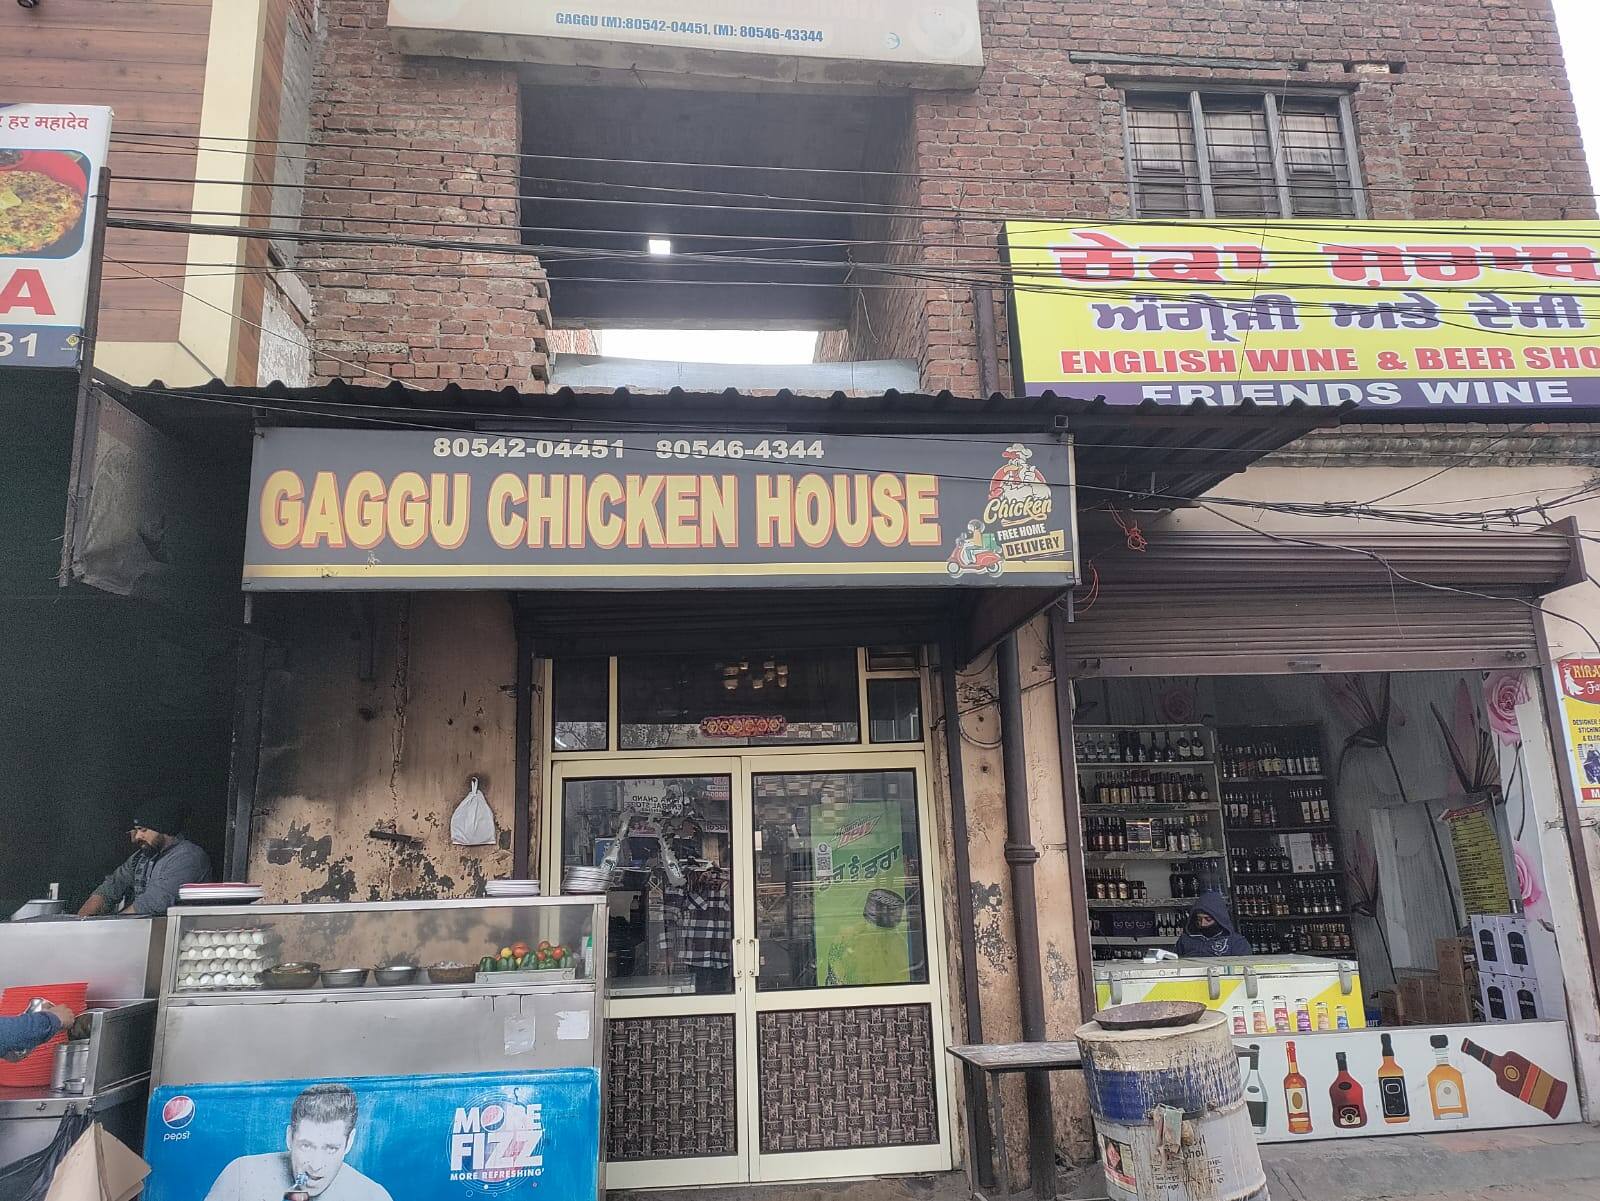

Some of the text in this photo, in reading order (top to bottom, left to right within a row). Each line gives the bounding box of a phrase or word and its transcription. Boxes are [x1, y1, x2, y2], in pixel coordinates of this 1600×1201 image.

[555, 12, 599, 27] GAGGU
[740, 25, 824, 43] 80546-43344
[8, 115, 30, 130] हर
[35, 111, 90, 132] महादेव
[1050, 231, 1269, 284] ਠੇਕਾ
[1060, 346, 1600, 374] ENGLISH WINE & BEER SHO
[1141, 381, 1573, 406] FRIENDS WINE
[433, 437, 825, 460] 80542-04451 80546-4344
[259, 469, 941, 550] GAGGU CHICKEN HOUSE
[983, 496, 1052, 524] Chicken
[997, 523, 1047, 541] FREE HOME
[1005, 536, 1060, 557] DELIVERY
[163, 1130, 190, 1142] pepsi
[450, 1130, 543, 1171] FIZZ
[450, 1171, 481, 1181] MORE
